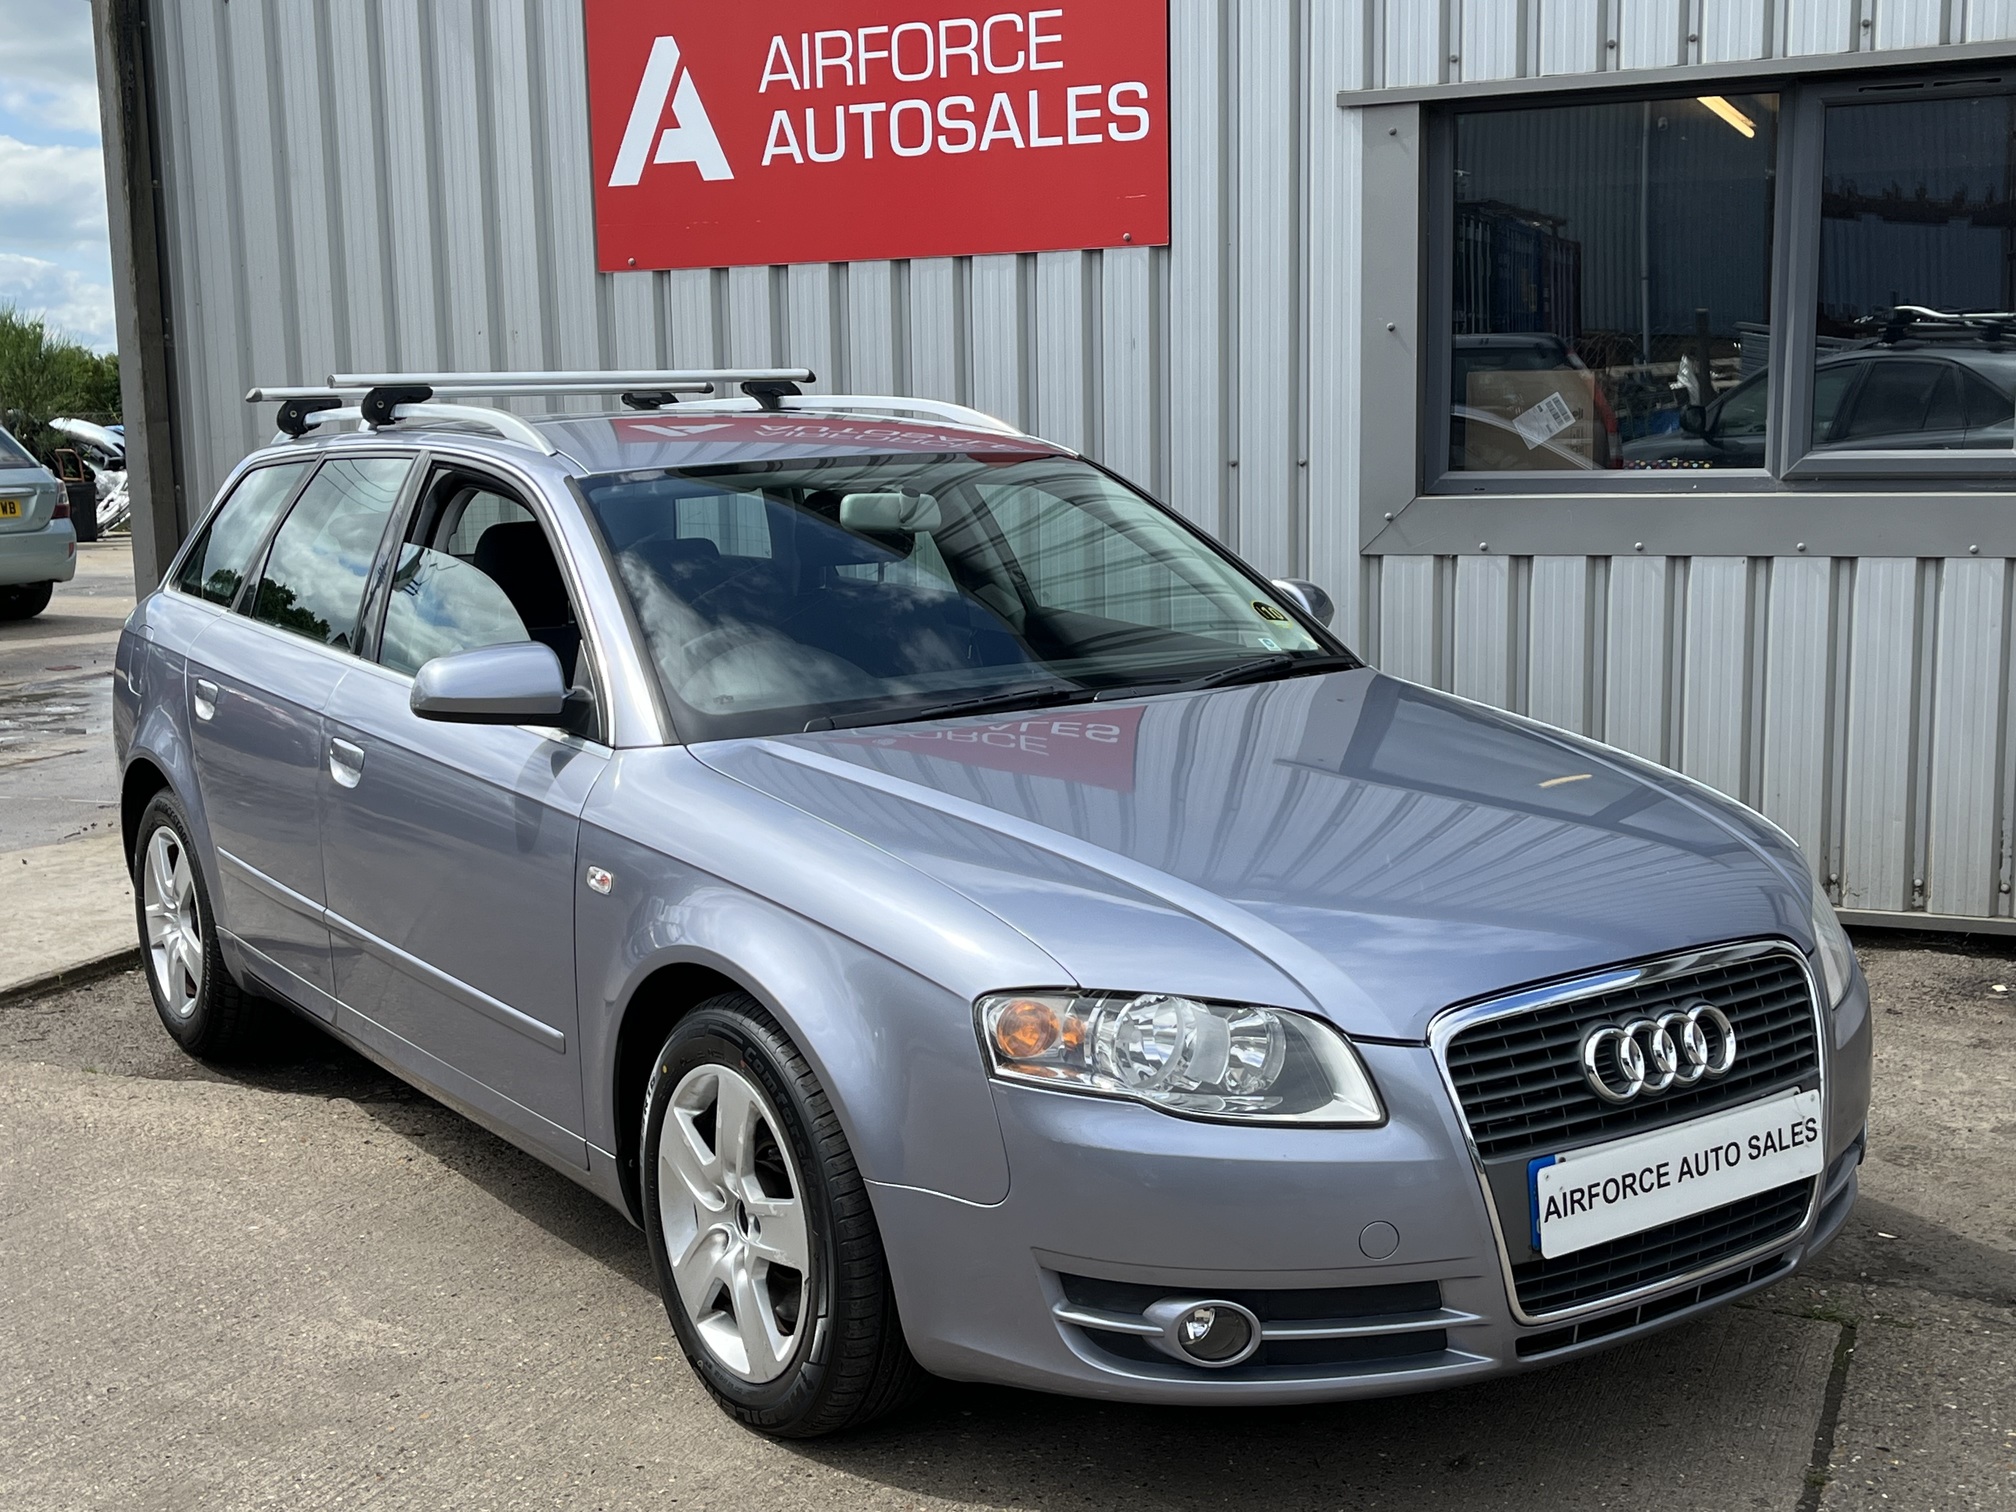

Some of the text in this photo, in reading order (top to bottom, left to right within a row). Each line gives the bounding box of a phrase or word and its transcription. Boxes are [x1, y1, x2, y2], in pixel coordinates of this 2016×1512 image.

[759, 9, 1064, 94] AIRFORCE
[761, 81, 1150, 166] AUTOSALES
[1543, 1117, 1819, 1223] AIRFORCE AUTO SALES
